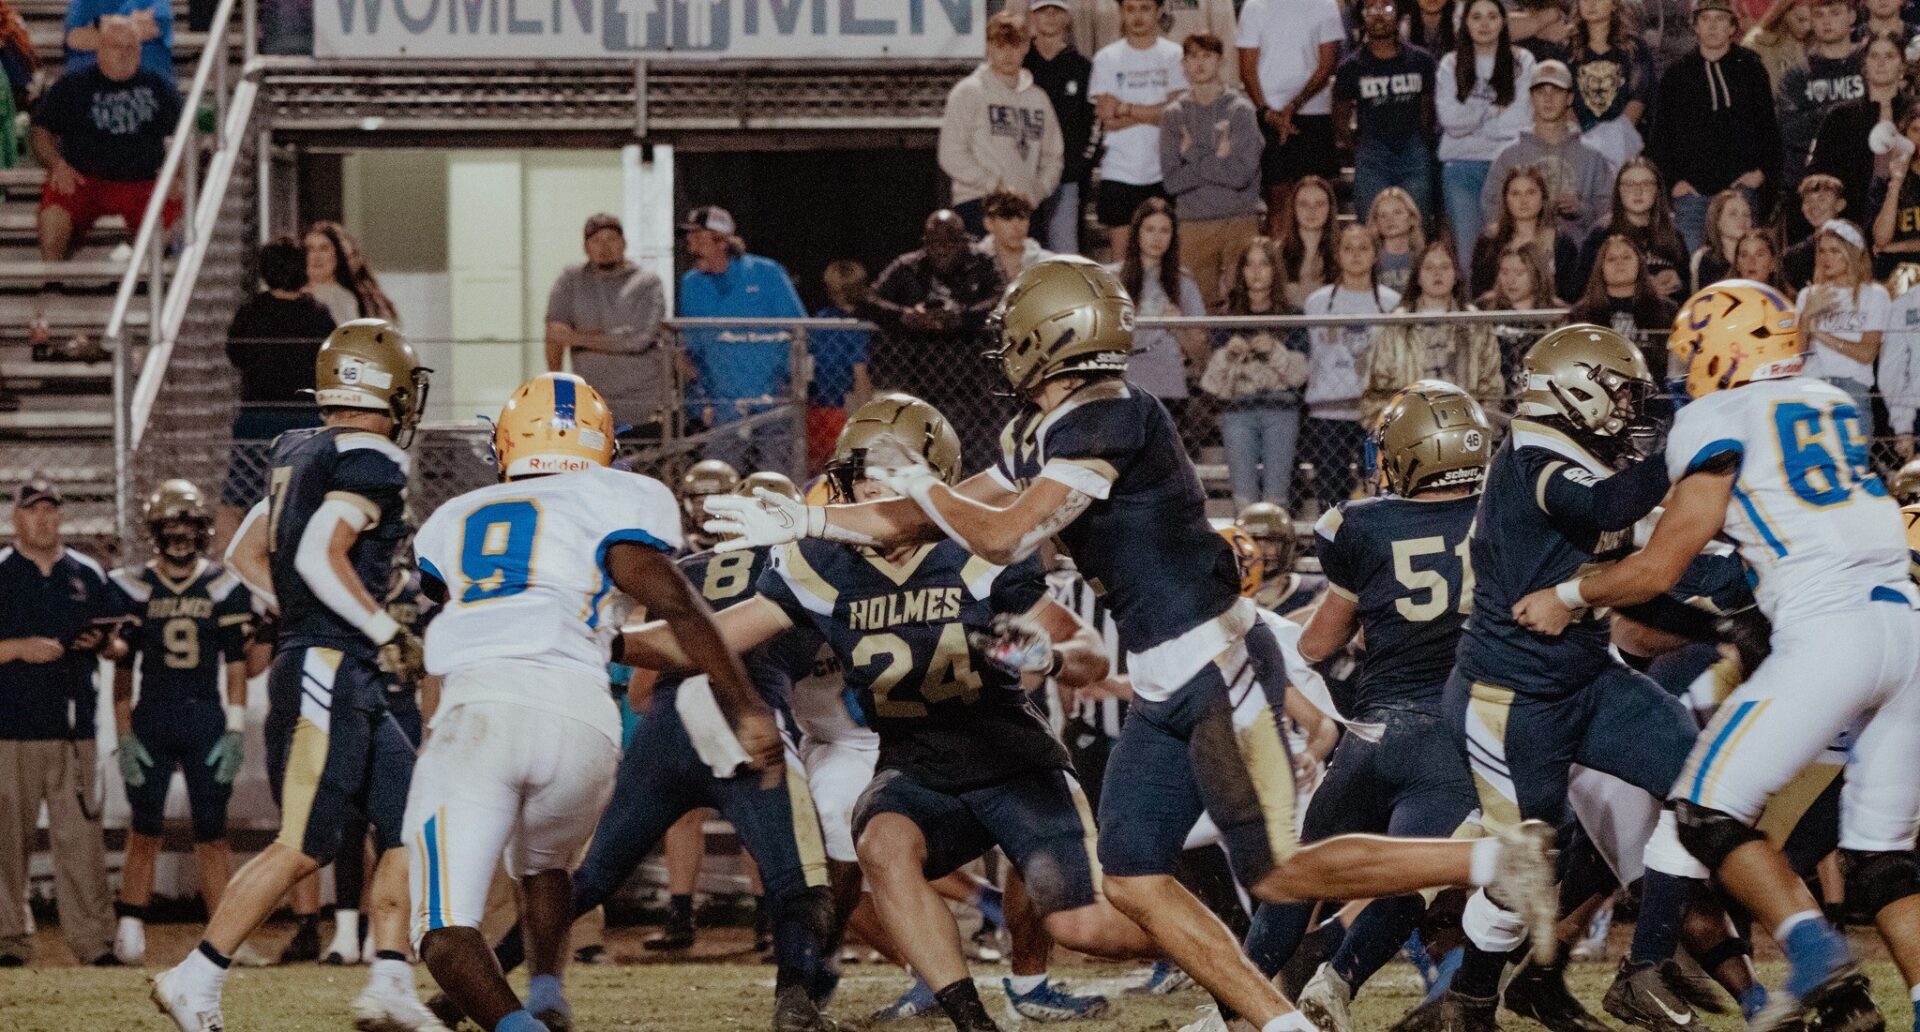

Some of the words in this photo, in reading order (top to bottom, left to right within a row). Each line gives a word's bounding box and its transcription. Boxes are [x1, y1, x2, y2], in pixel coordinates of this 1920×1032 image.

[457, 498, 545, 608] 9
[702, 549, 756, 601] 8
[1391, 535, 1476, 622] 51
[849, 587, 962, 630] HOLMES
[163, 618, 200, 670] 9
[851, 621, 984, 718] 24
